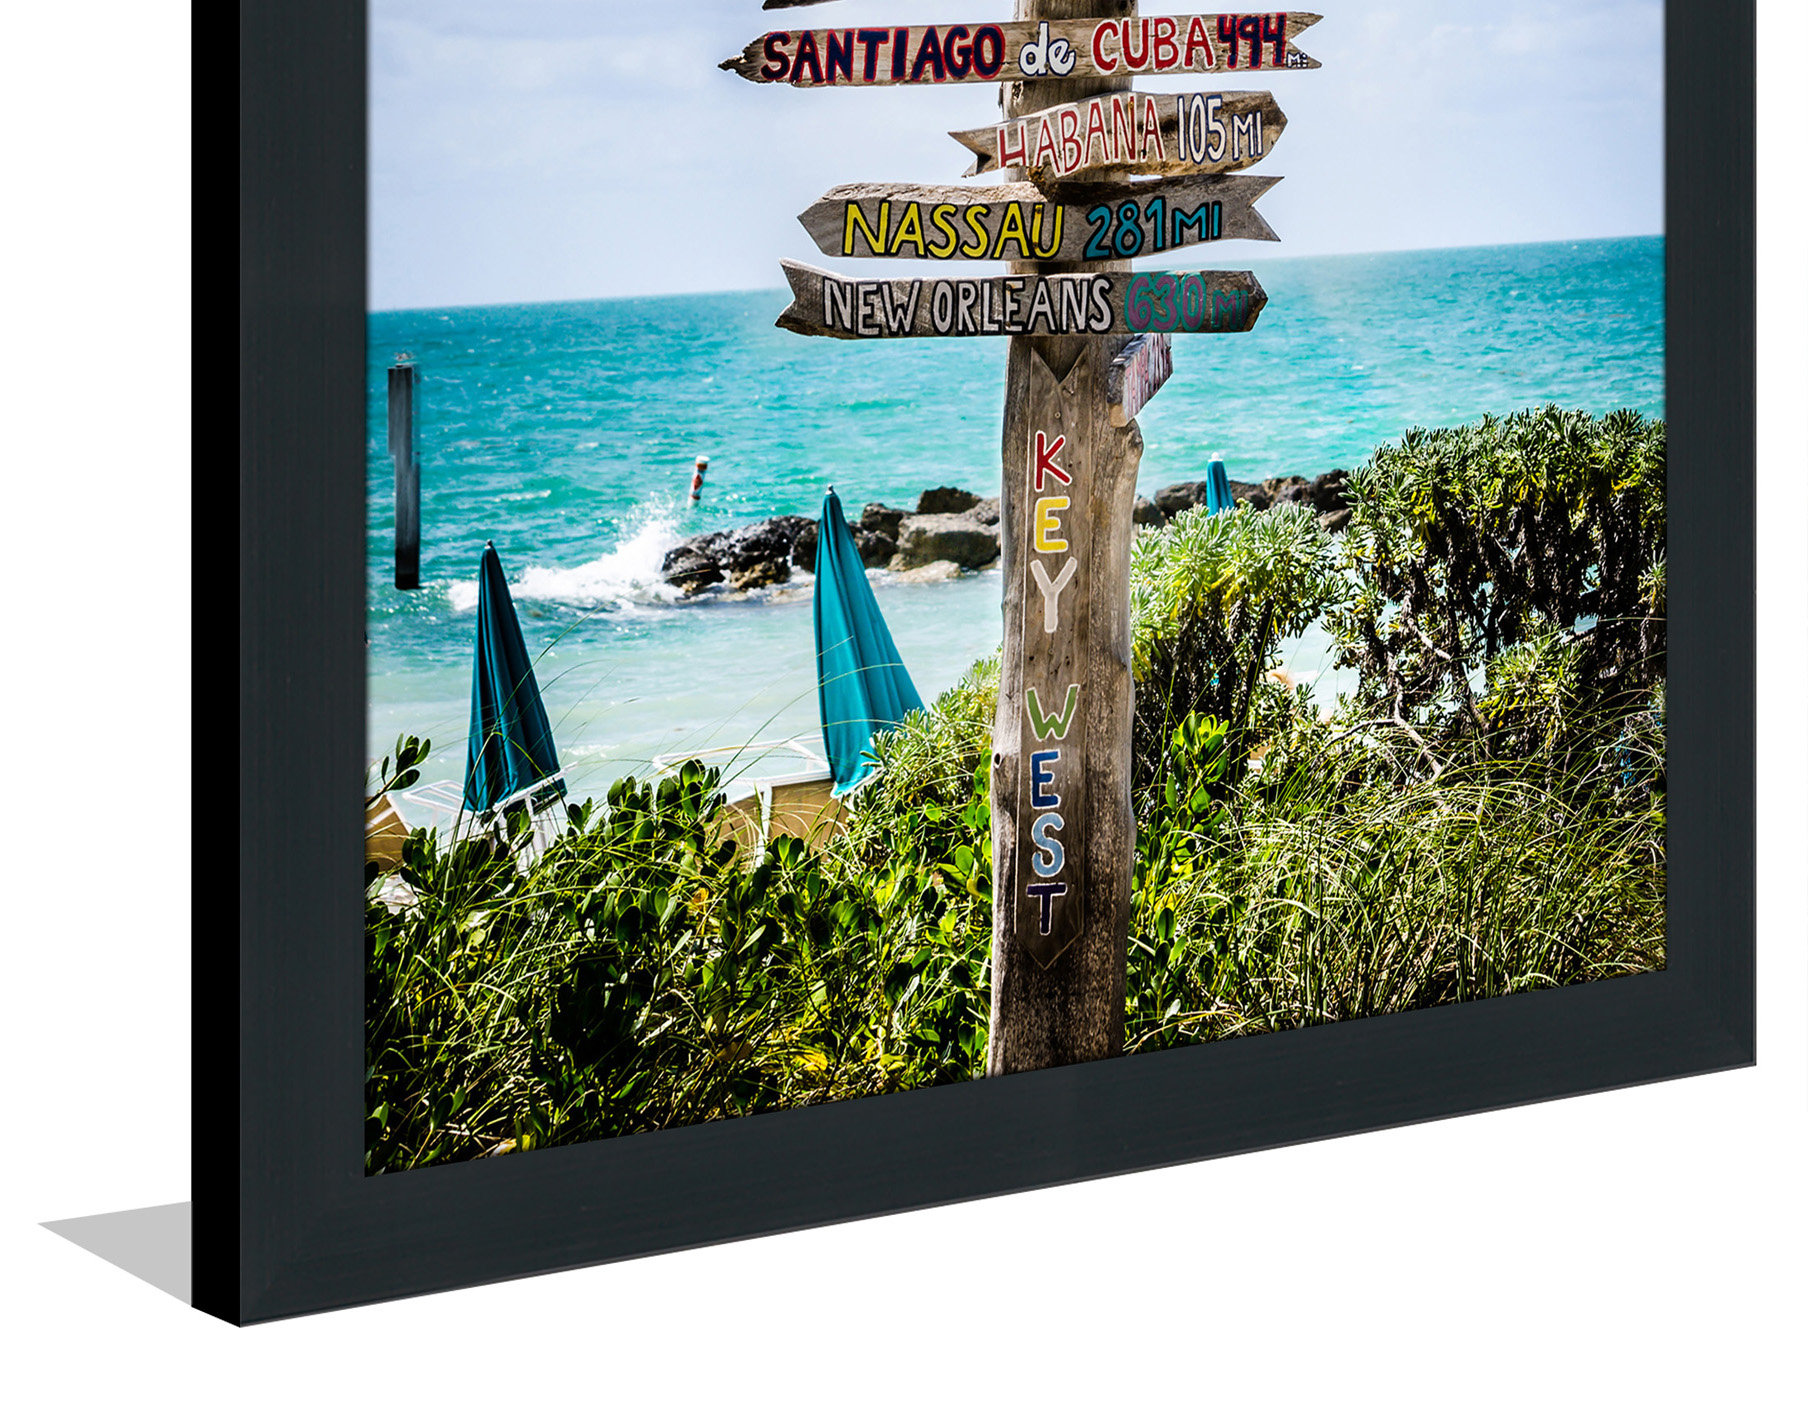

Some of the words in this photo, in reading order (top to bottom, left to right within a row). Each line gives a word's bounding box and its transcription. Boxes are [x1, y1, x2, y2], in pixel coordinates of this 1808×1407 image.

[758, 23, 1006, 84] SANTIAGO
[1018, 20, 1077, 78] de
[1091, 14, 1215, 77] CUBA
[1216, 12, 1287, 69] 494
[997, 92, 1166, 178] HABANA
[1178, 92, 1227, 165] 105
[1231, 110, 1264, 162] MI
[841, 200, 1066, 260] NASSAU
[1082, 195, 1167, 261] 281
[1173, 198, 1223, 243] MI
[822, 277, 922, 335] NEW
[932, 276, 1113, 335] ORLEANS
[1124, 272, 1207, 333] 630
[1211, 289, 1249, 331] MI
[1029, 431, 1078, 635] KEY
[1024, 683, 1081, 936] WEST
